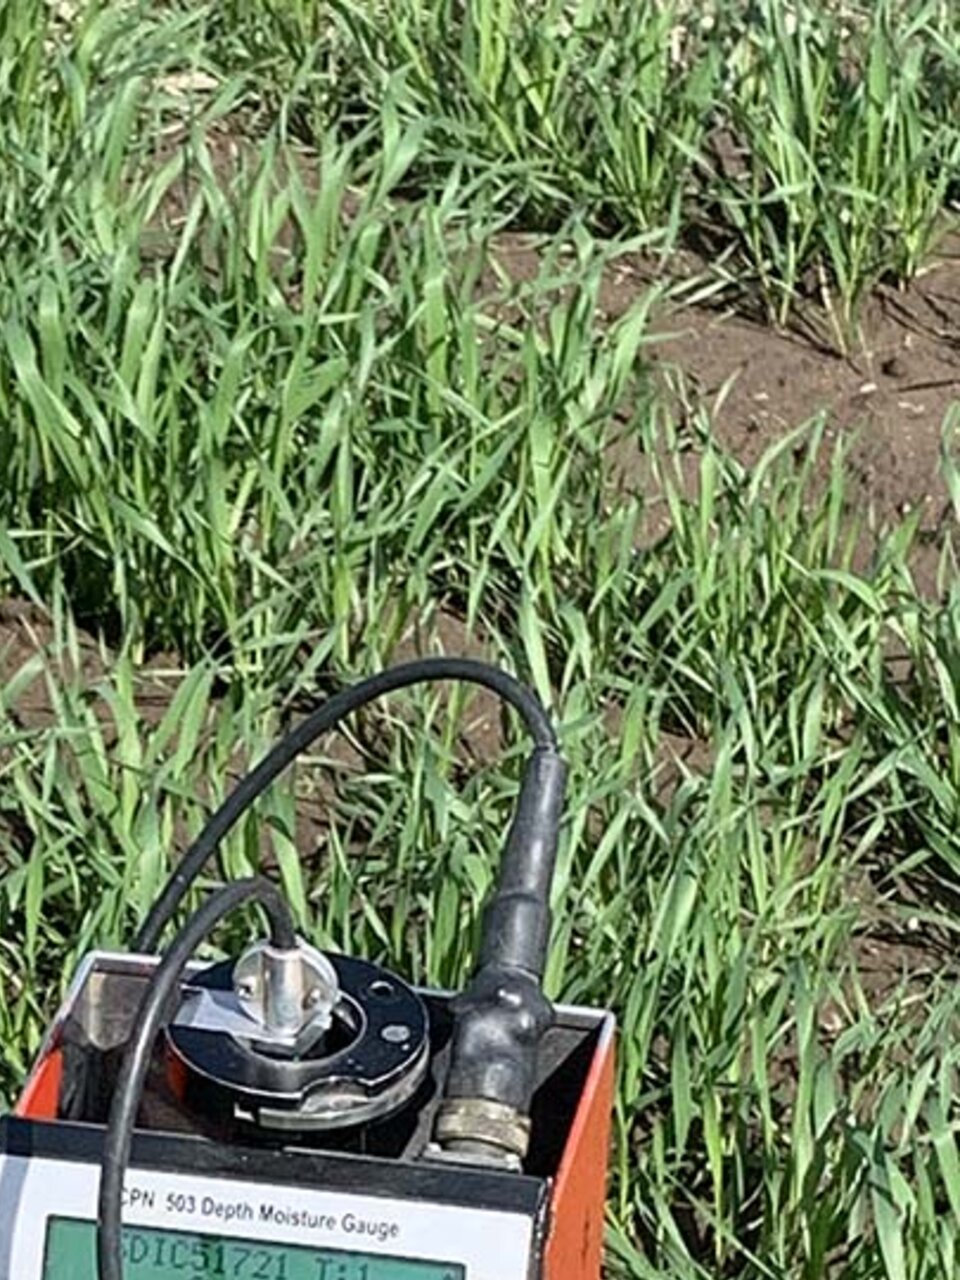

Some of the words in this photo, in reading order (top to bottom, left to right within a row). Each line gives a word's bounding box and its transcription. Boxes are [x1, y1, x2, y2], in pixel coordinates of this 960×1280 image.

[166, 1192, 196, 1214] 503
[201, 1196, 254, 1222] Depth
[259, 1204, 337, 1230] Moisture
[341, 1213, 400, 1242] Gauge
